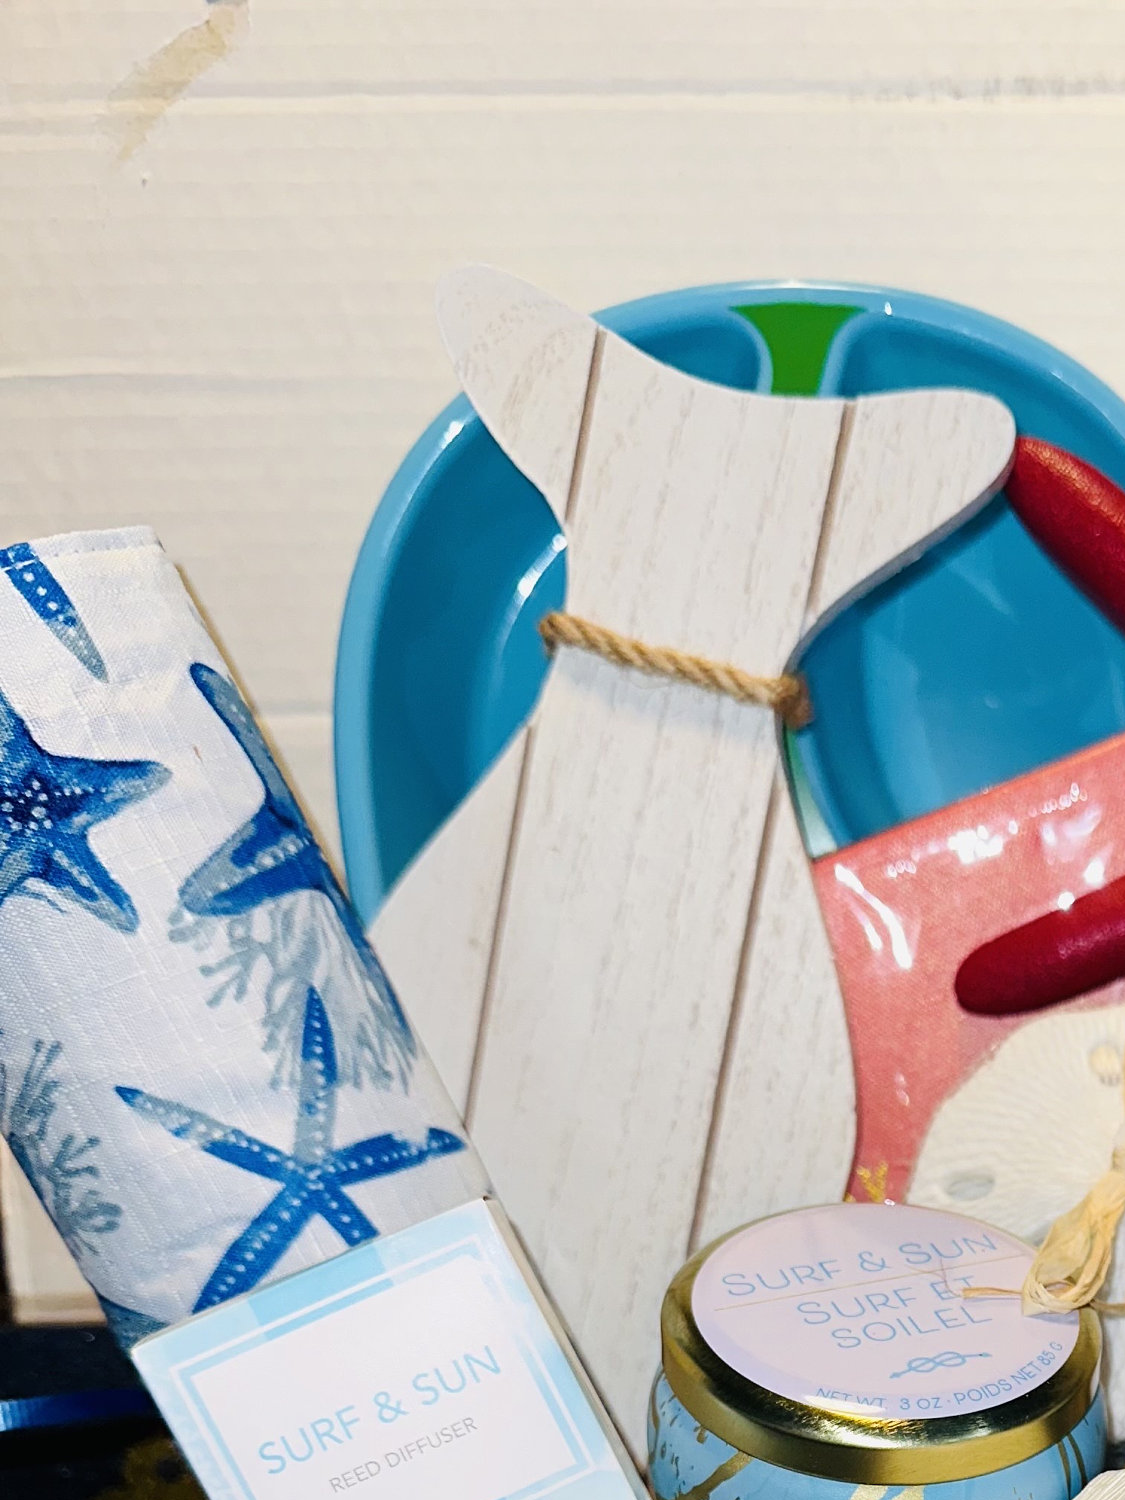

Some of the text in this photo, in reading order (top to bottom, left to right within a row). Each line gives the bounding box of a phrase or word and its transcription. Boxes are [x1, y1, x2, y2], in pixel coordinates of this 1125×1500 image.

[722, 1234, 998, 1297] SURF & SUN
[796, 1286, 917, 1325] SURF
[831, 1306, 993, 1349] SOILEL
[900, 1396, 911, 1410] 3
[916, 1395, 943, 1410] OZ
[953, 1378, 1014, 1405] POIDS
[1010, 1361, 1042, 1385] NET
[1037, 1350, 1056, 1366] 85
[1049, 1341, 1063, 1351] G
[258, 1345, 502, 1475] SURF & SUN
[329, 1416, 479, 1493] REED DIFFUSER
